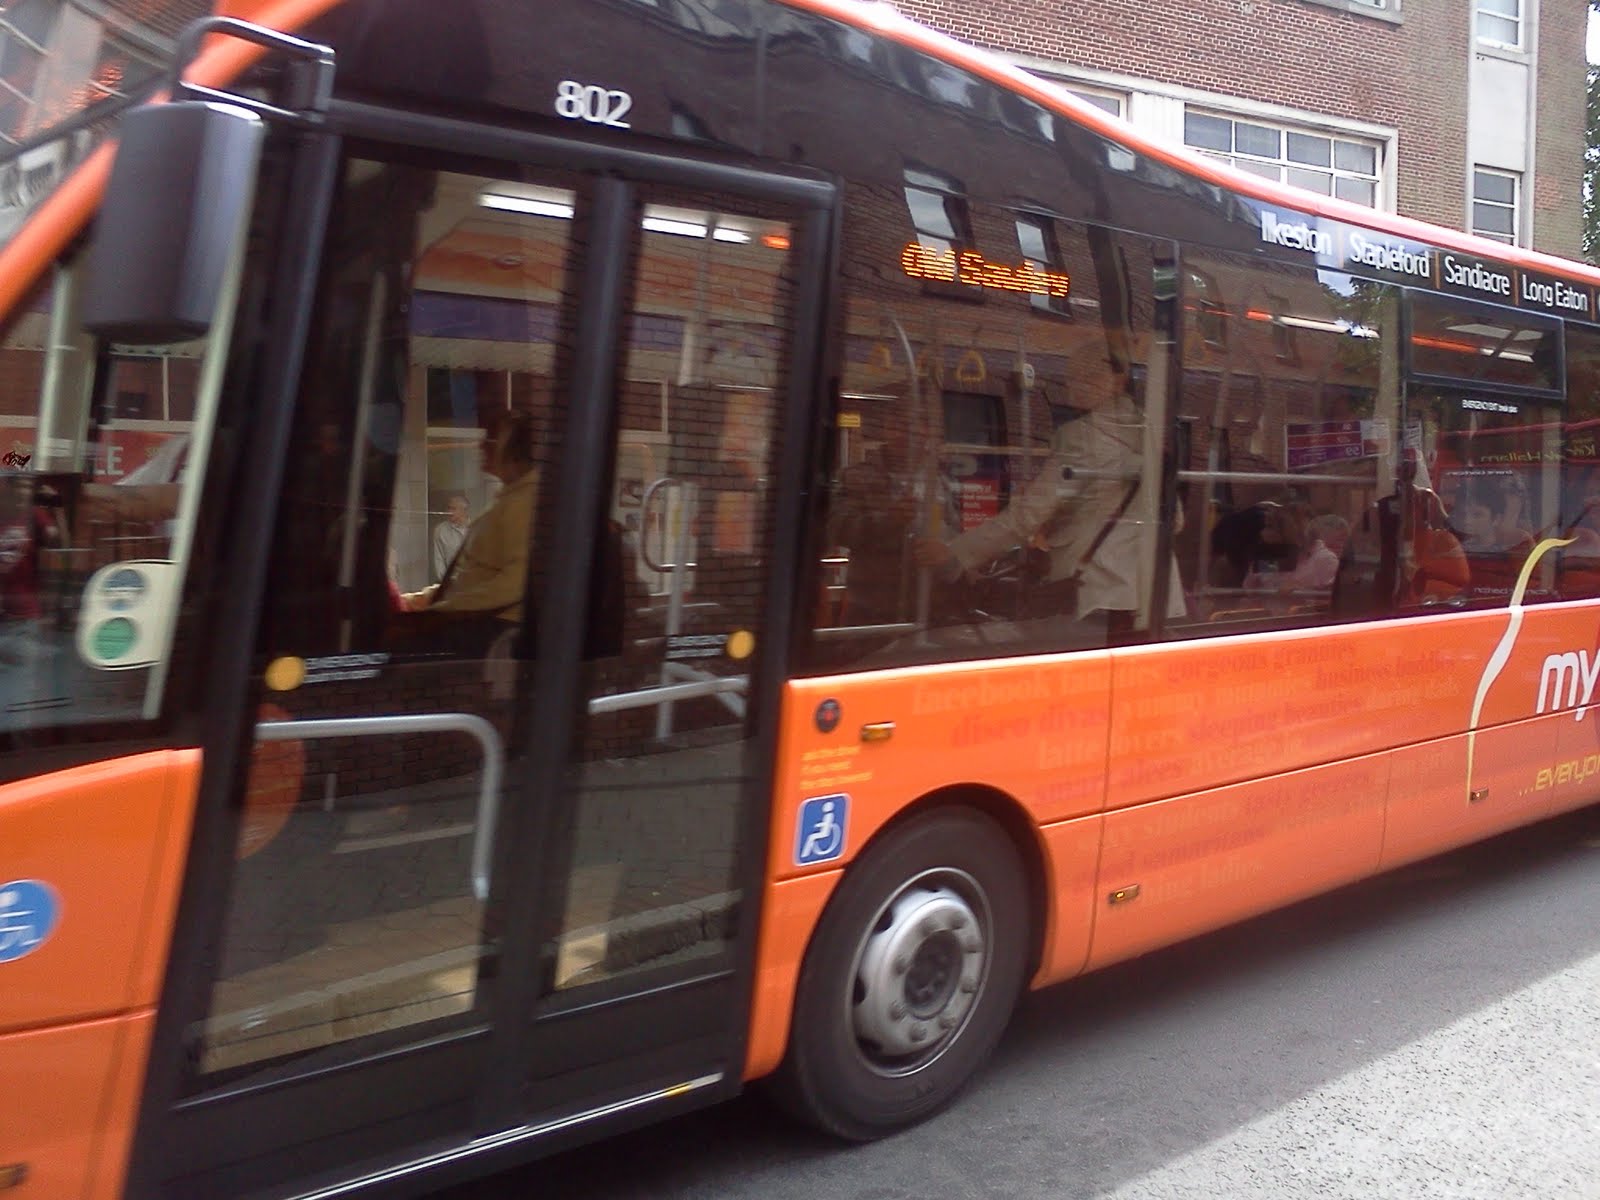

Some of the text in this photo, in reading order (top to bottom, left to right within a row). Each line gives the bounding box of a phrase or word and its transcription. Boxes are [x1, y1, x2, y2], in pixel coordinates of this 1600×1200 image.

[554, 80, 632, 128] 802
[1261, 209, 1332, 256] Ilkeston
[1349, 232, 1431, 279] Stapleford
[1444, 256, 1511, 297] Sandiacre
[1522, 274, 1588, 311] Long Eaton
[1536, 649, 1600, 722] my
